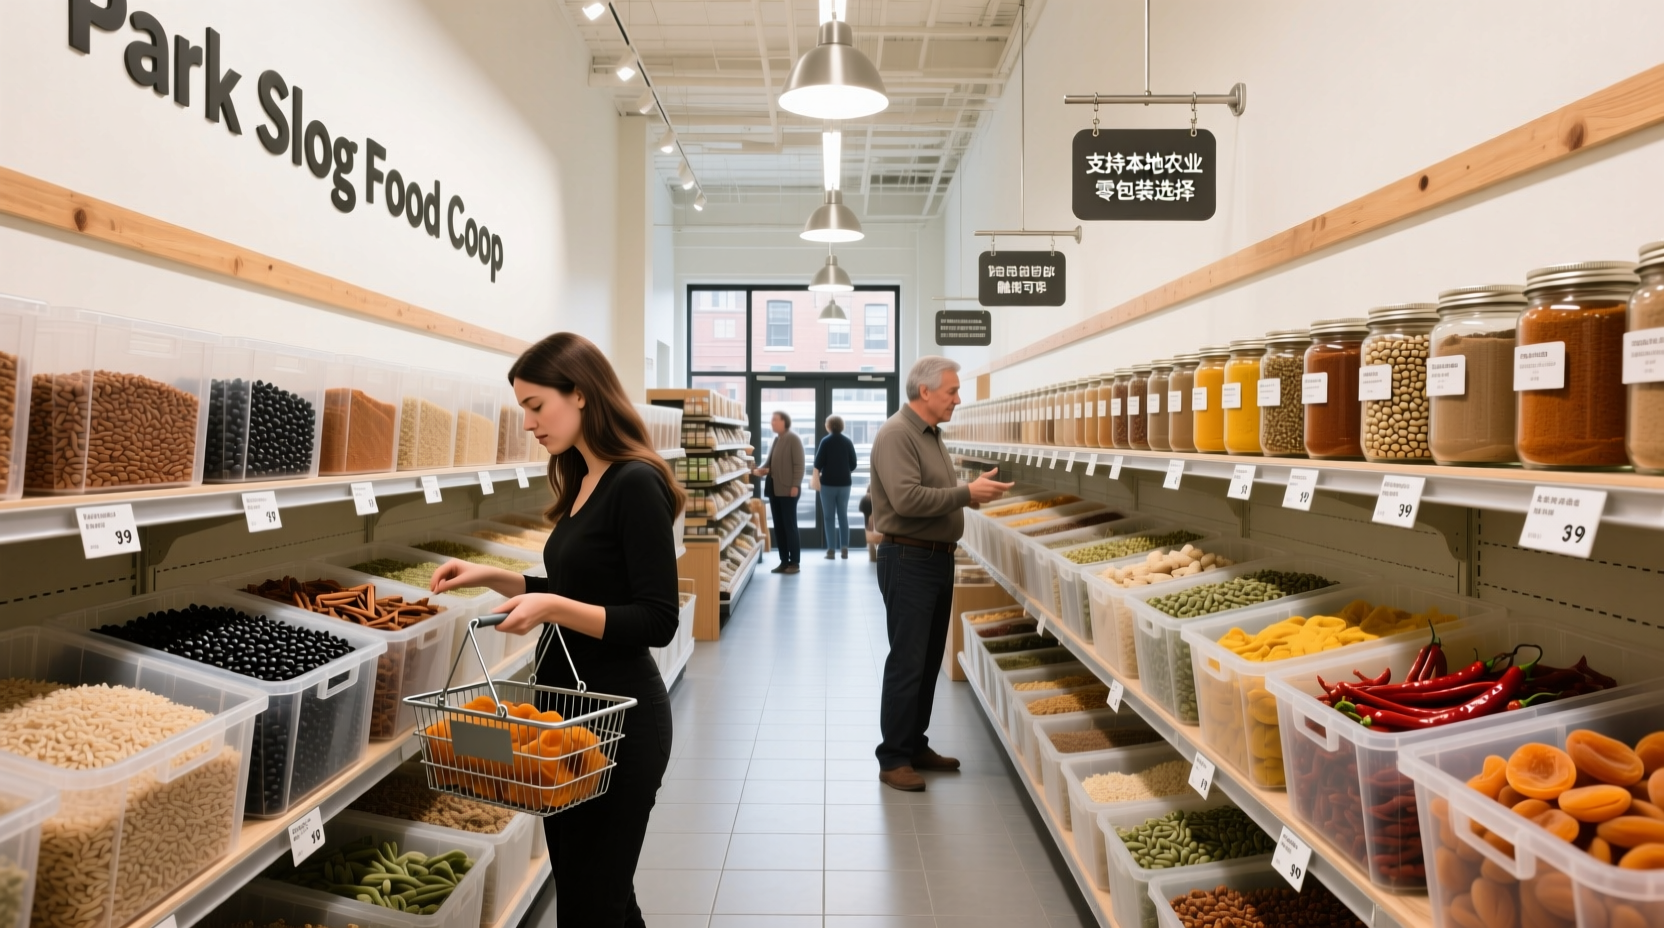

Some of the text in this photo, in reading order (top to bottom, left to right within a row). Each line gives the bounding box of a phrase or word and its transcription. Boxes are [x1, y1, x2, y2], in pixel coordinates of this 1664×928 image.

[68, 0, 503, 283] Park Slog Food Coop
[1086, 151, 1203, 175] 支持本地农业
[1095, 179, 1196, 202] 零包装选择
[1561, 524, 1586, 544] 39
